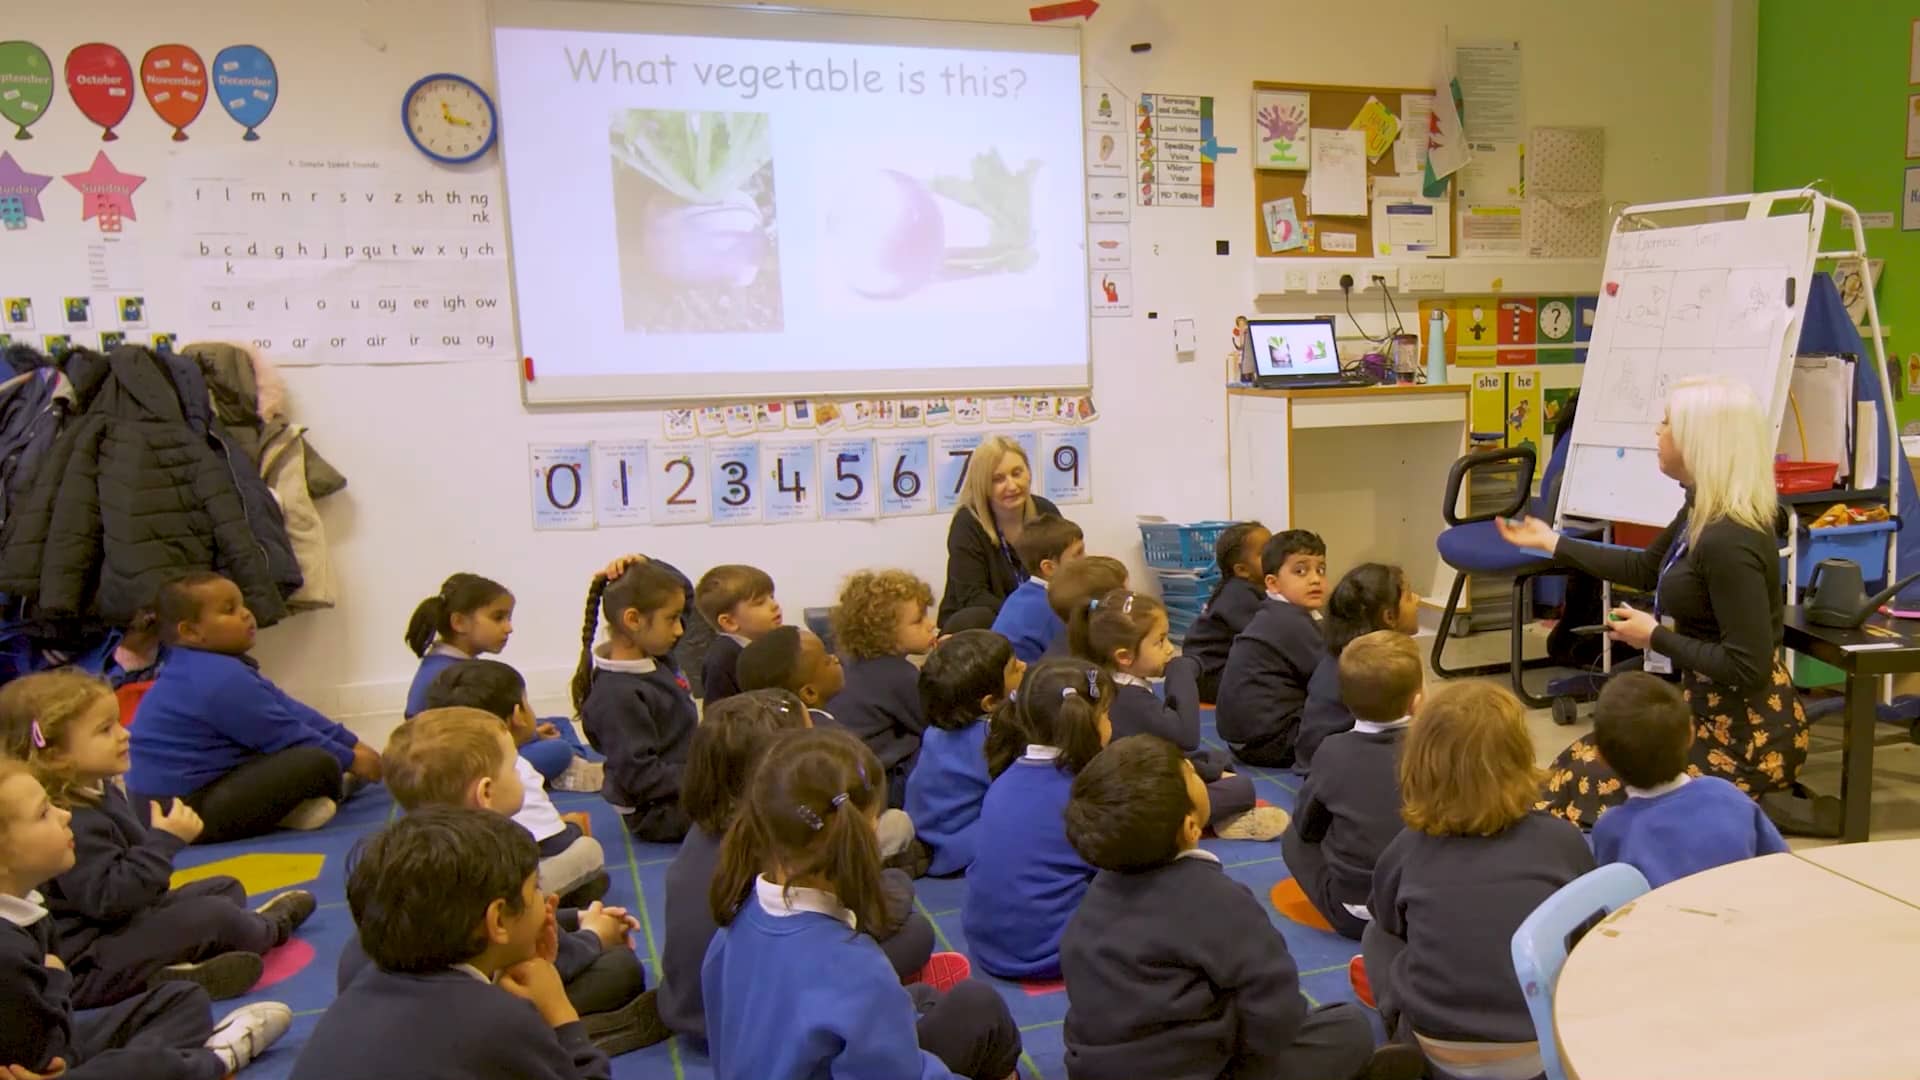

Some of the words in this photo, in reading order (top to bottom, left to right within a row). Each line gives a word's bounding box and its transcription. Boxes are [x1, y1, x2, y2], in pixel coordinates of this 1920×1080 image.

[76, 74, 123, 86] October
[146, 75, 203, 87] November
[218, 75, 273, 88] December
[563, 47, 678, 85] What
[693, 57, 884, 99] vegetable
[898, 62, 925, 95] is
[939, 62, 1027, 99] this?
[1160, 124, 1178, 133] Loud
[250, 191, 266, 202] m
[281, 191, 292, 202] n
[339, 193, 348, 203] s
[365, 193, 374, 202] v
[394, 193, 403, 204] z
[416, 190, 434, 204] sh
[445, 190, 462, 204] th
[470, 194, 489, 208] ng
[472, 210, 490, 223] nk
[200, 241, 210, 257] b
[223, 245, 233, 257] c
[247, 241, 258, 257] d
[274, 245, 285, 260] g
[297, 241, 308, 256] h
[344, 245, 355, 259] p
[361, 245, 382, 260] qu
[391, 243, 399, 256] t
[410, 246, 425, 256] w
[437, 245, 446, 256] x
[459, 246, 469, 259] y
[477, 242, 495, 256] ch
[225, 261, 235, 275] k
[211, 300, 222, 312] a
[246, 300, 256, 311] e
[316, 299, 327, 310] o
[350, 299, 360, 310] u
[377, 299, 398, 313] ay
[412, 299, 429, 309] ee
[443, 296, 467, 313] igh
[474, 298, 498, 309] ow
[291, 338, 307, 349] ar
[329, 337, 347, 348] or
[365, 334, 388, 348] air
[409, 333, 421, 347] ir
[440, 335, 461, 346] ou
[475, 335, 495, 348] oy
[1479, 375, 1499, 388] she
[1517, 376, 1532, 388] he
[949, 450, 974, 494] 7
[1053, 445, 1080, 487] 9
[620, 459, 629, 506] 1
[664, 459, 697, 505] 2
[721, 461, 751, 506] 3
[777, 457, 806, 503] 4
[835, 453, 864, 500] 5
[893, 454, 921, 498] 6
[546, 463, 581, 510] 0
